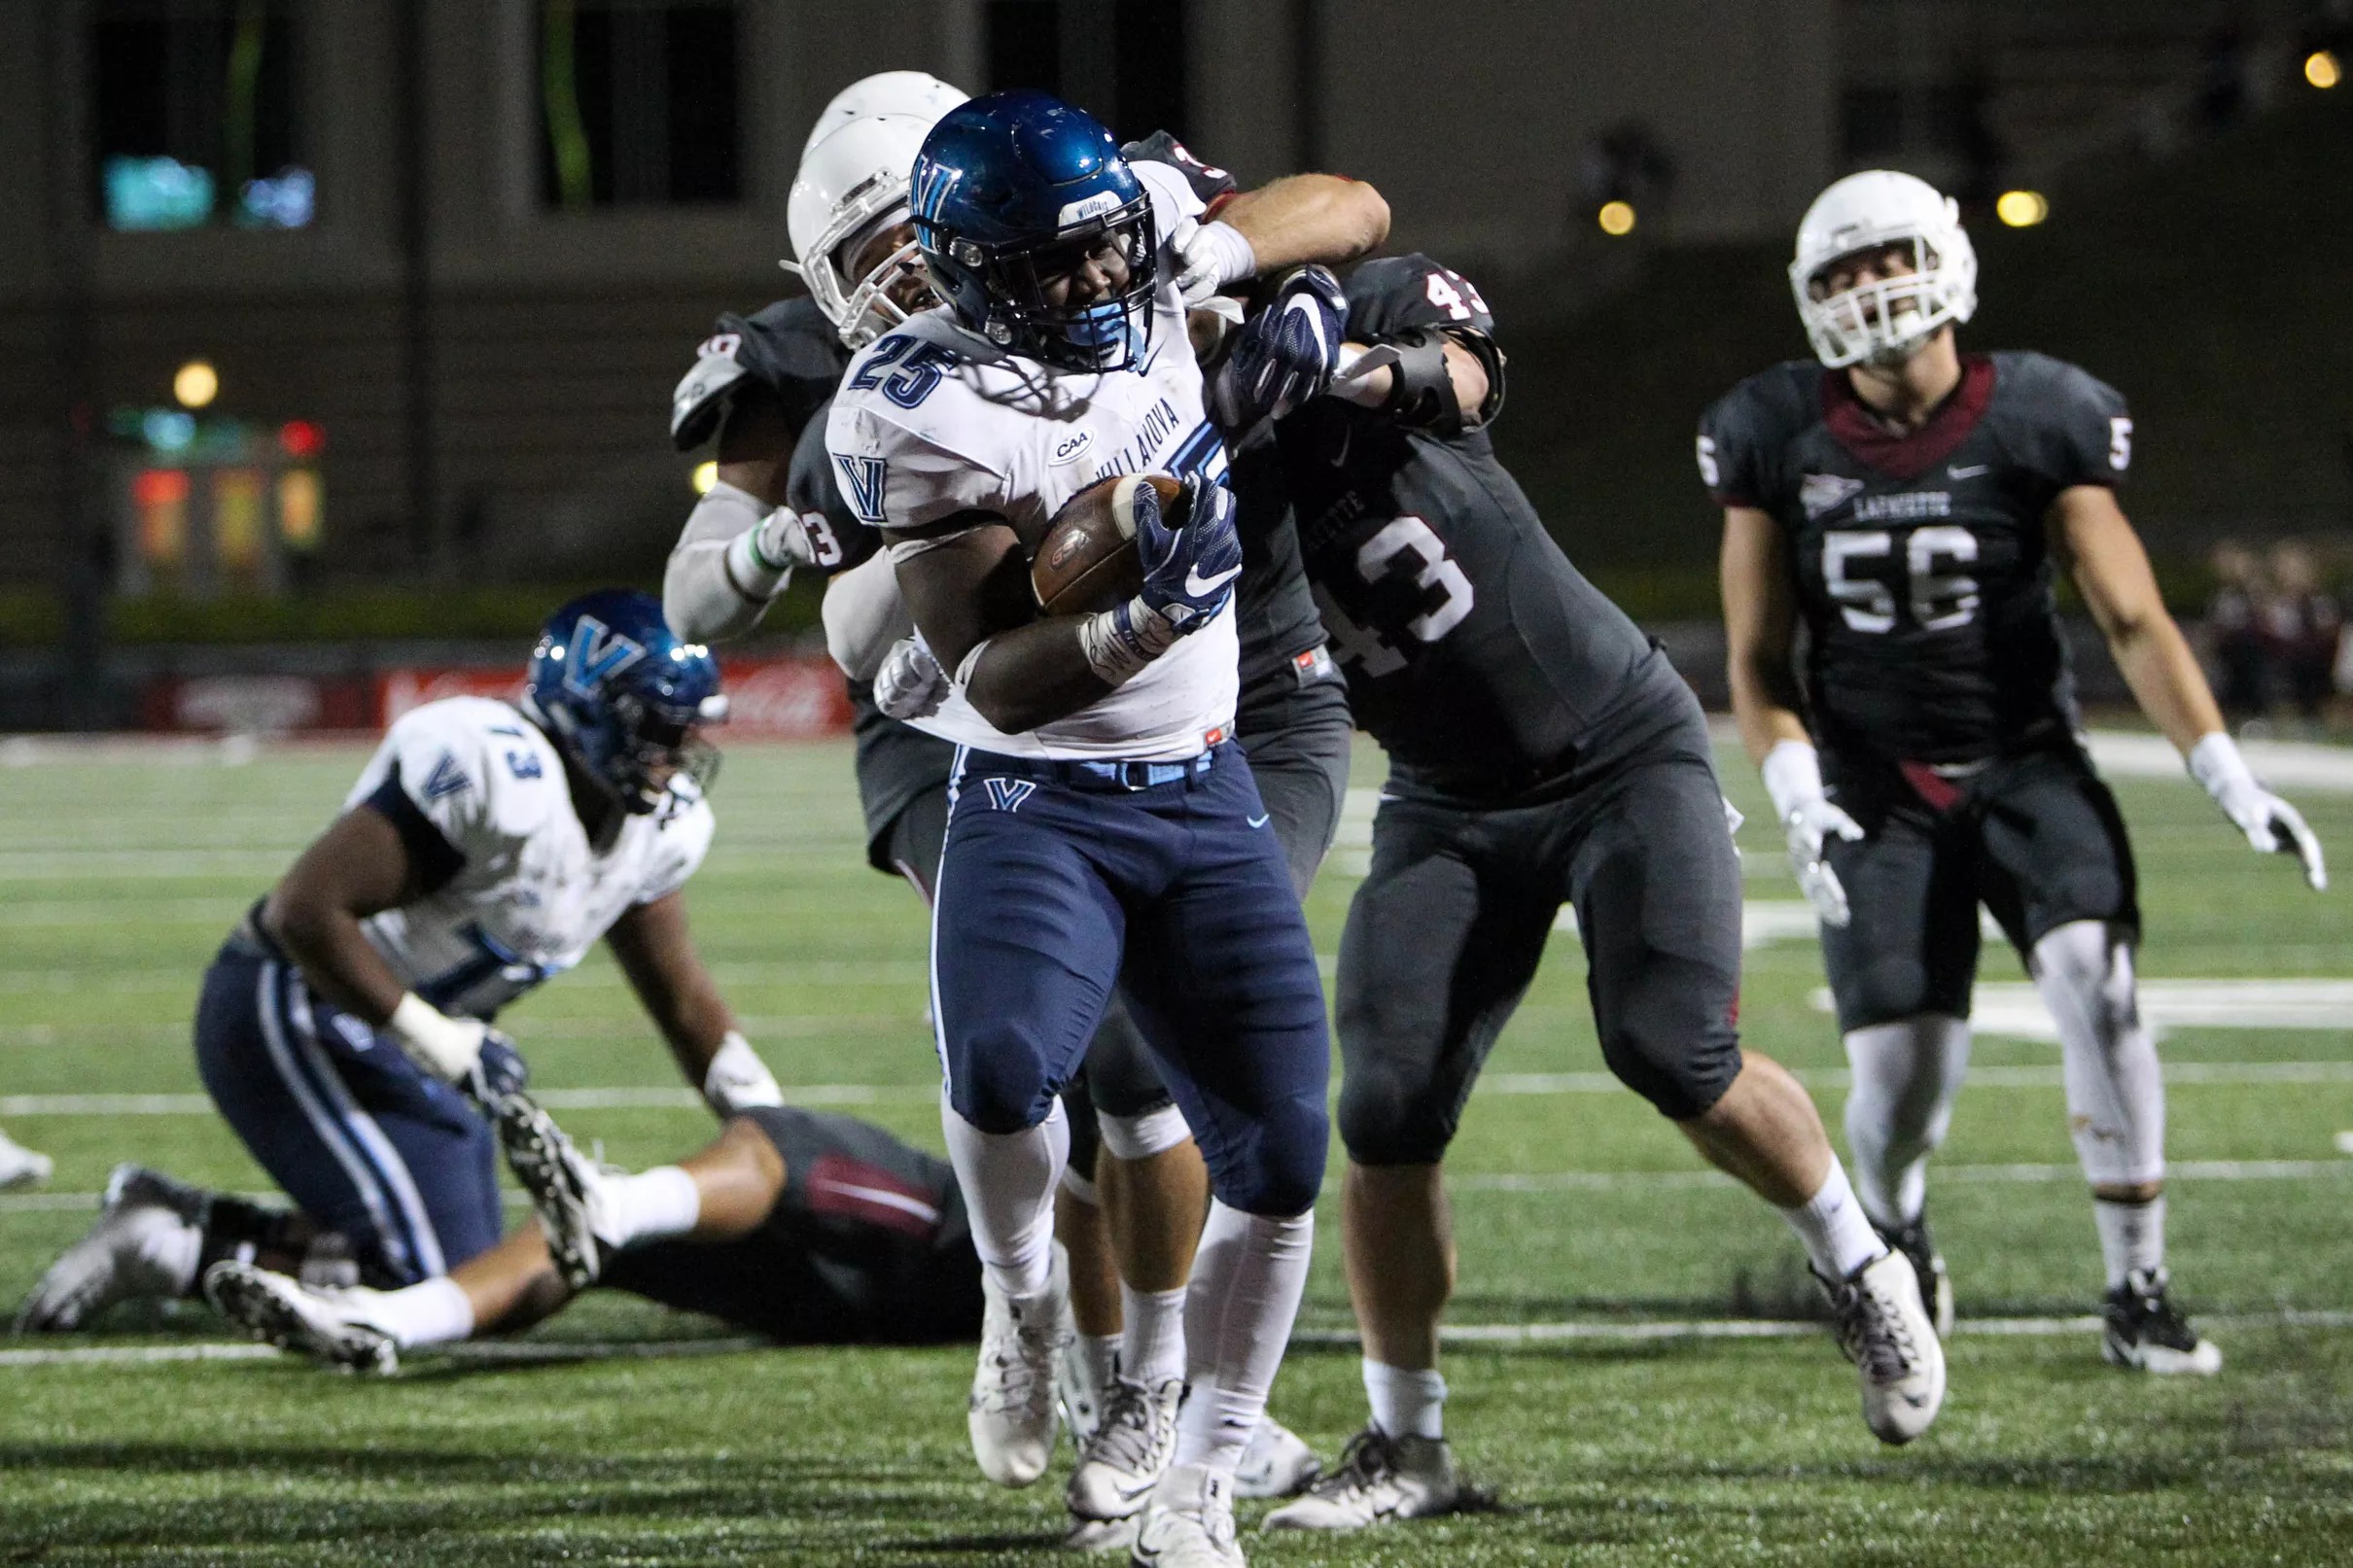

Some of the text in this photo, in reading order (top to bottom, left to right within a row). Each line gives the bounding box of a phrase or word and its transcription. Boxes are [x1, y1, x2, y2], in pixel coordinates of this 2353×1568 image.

[848, 333, 960, 409] 25
[1057, 432, 1088, 458] CAA
[1313, 516, 1474, 679] 43
[1821, 525, 1981, 634] 56
